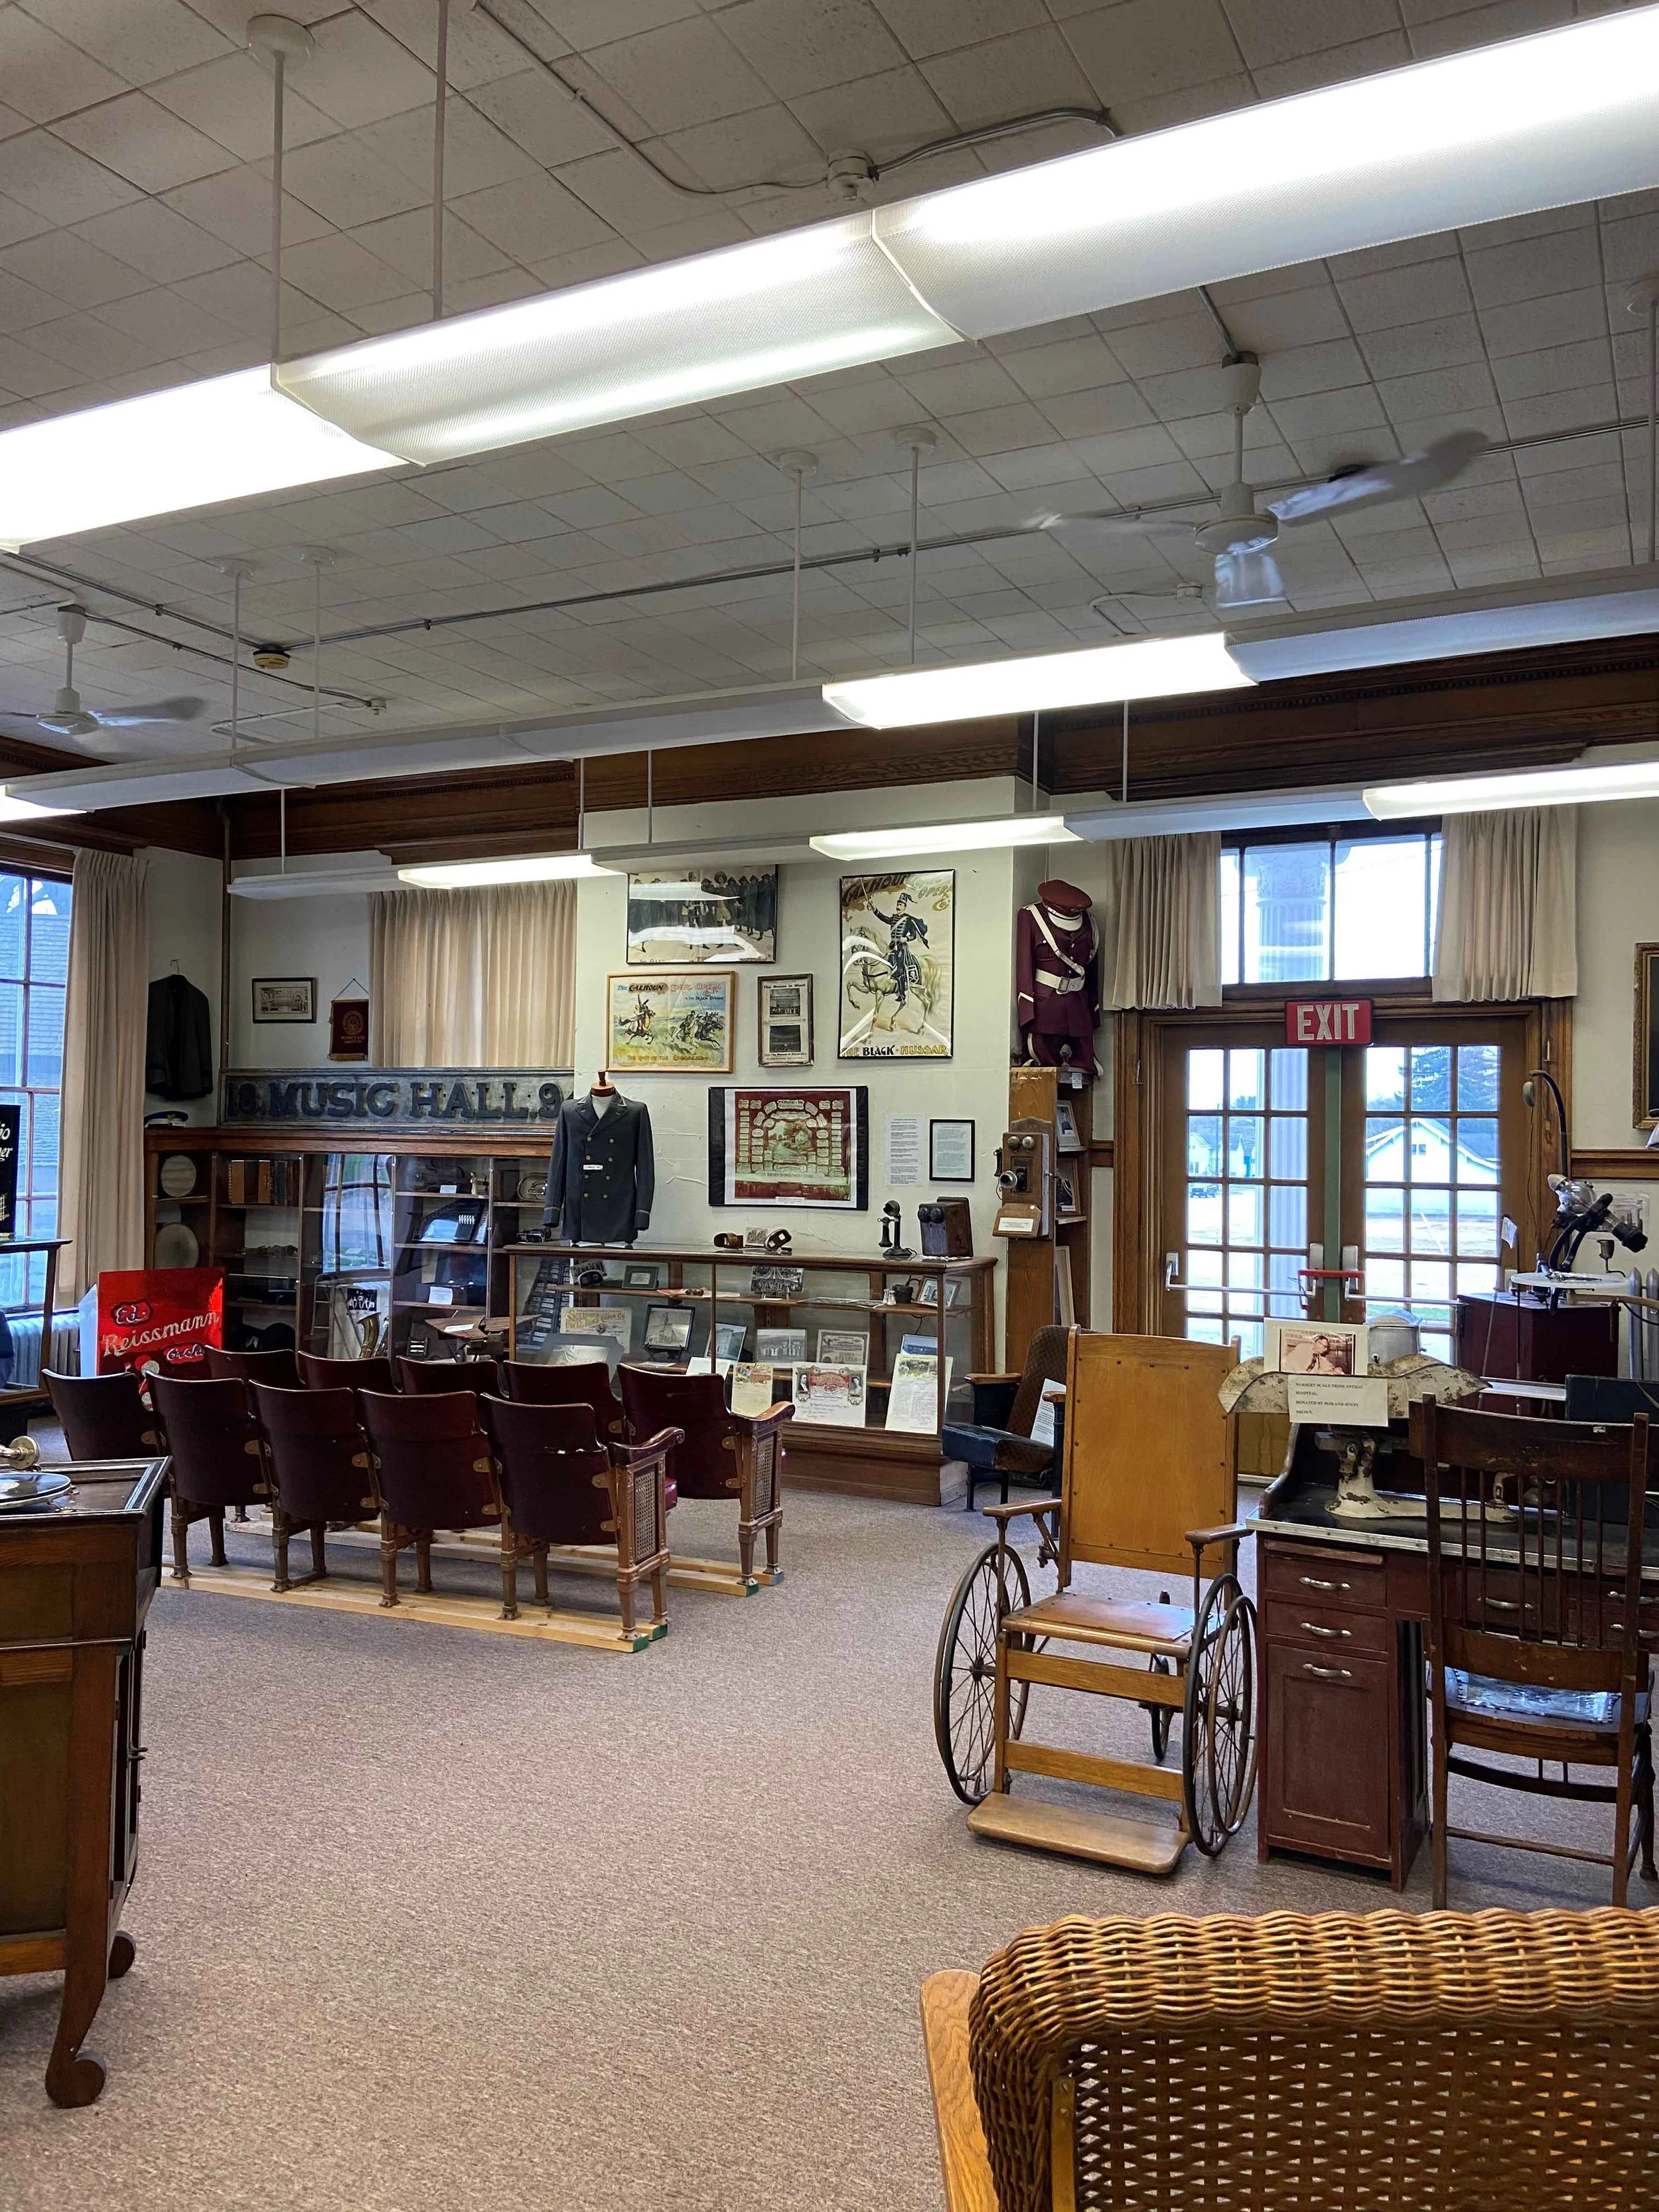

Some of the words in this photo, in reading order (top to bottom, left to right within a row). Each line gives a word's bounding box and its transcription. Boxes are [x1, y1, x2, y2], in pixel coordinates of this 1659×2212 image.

[1297, 1003, 1359, 1041] EXIT
[863, 1045, 895, 1056] BLACK
[900, 1045, 948, 1055] HUSSAR
[267, 1082, 398, 1118] MUSIC
[409, 1082, 529, 1118] HALL
[102, 1311, 220, 1357] Reissmann
